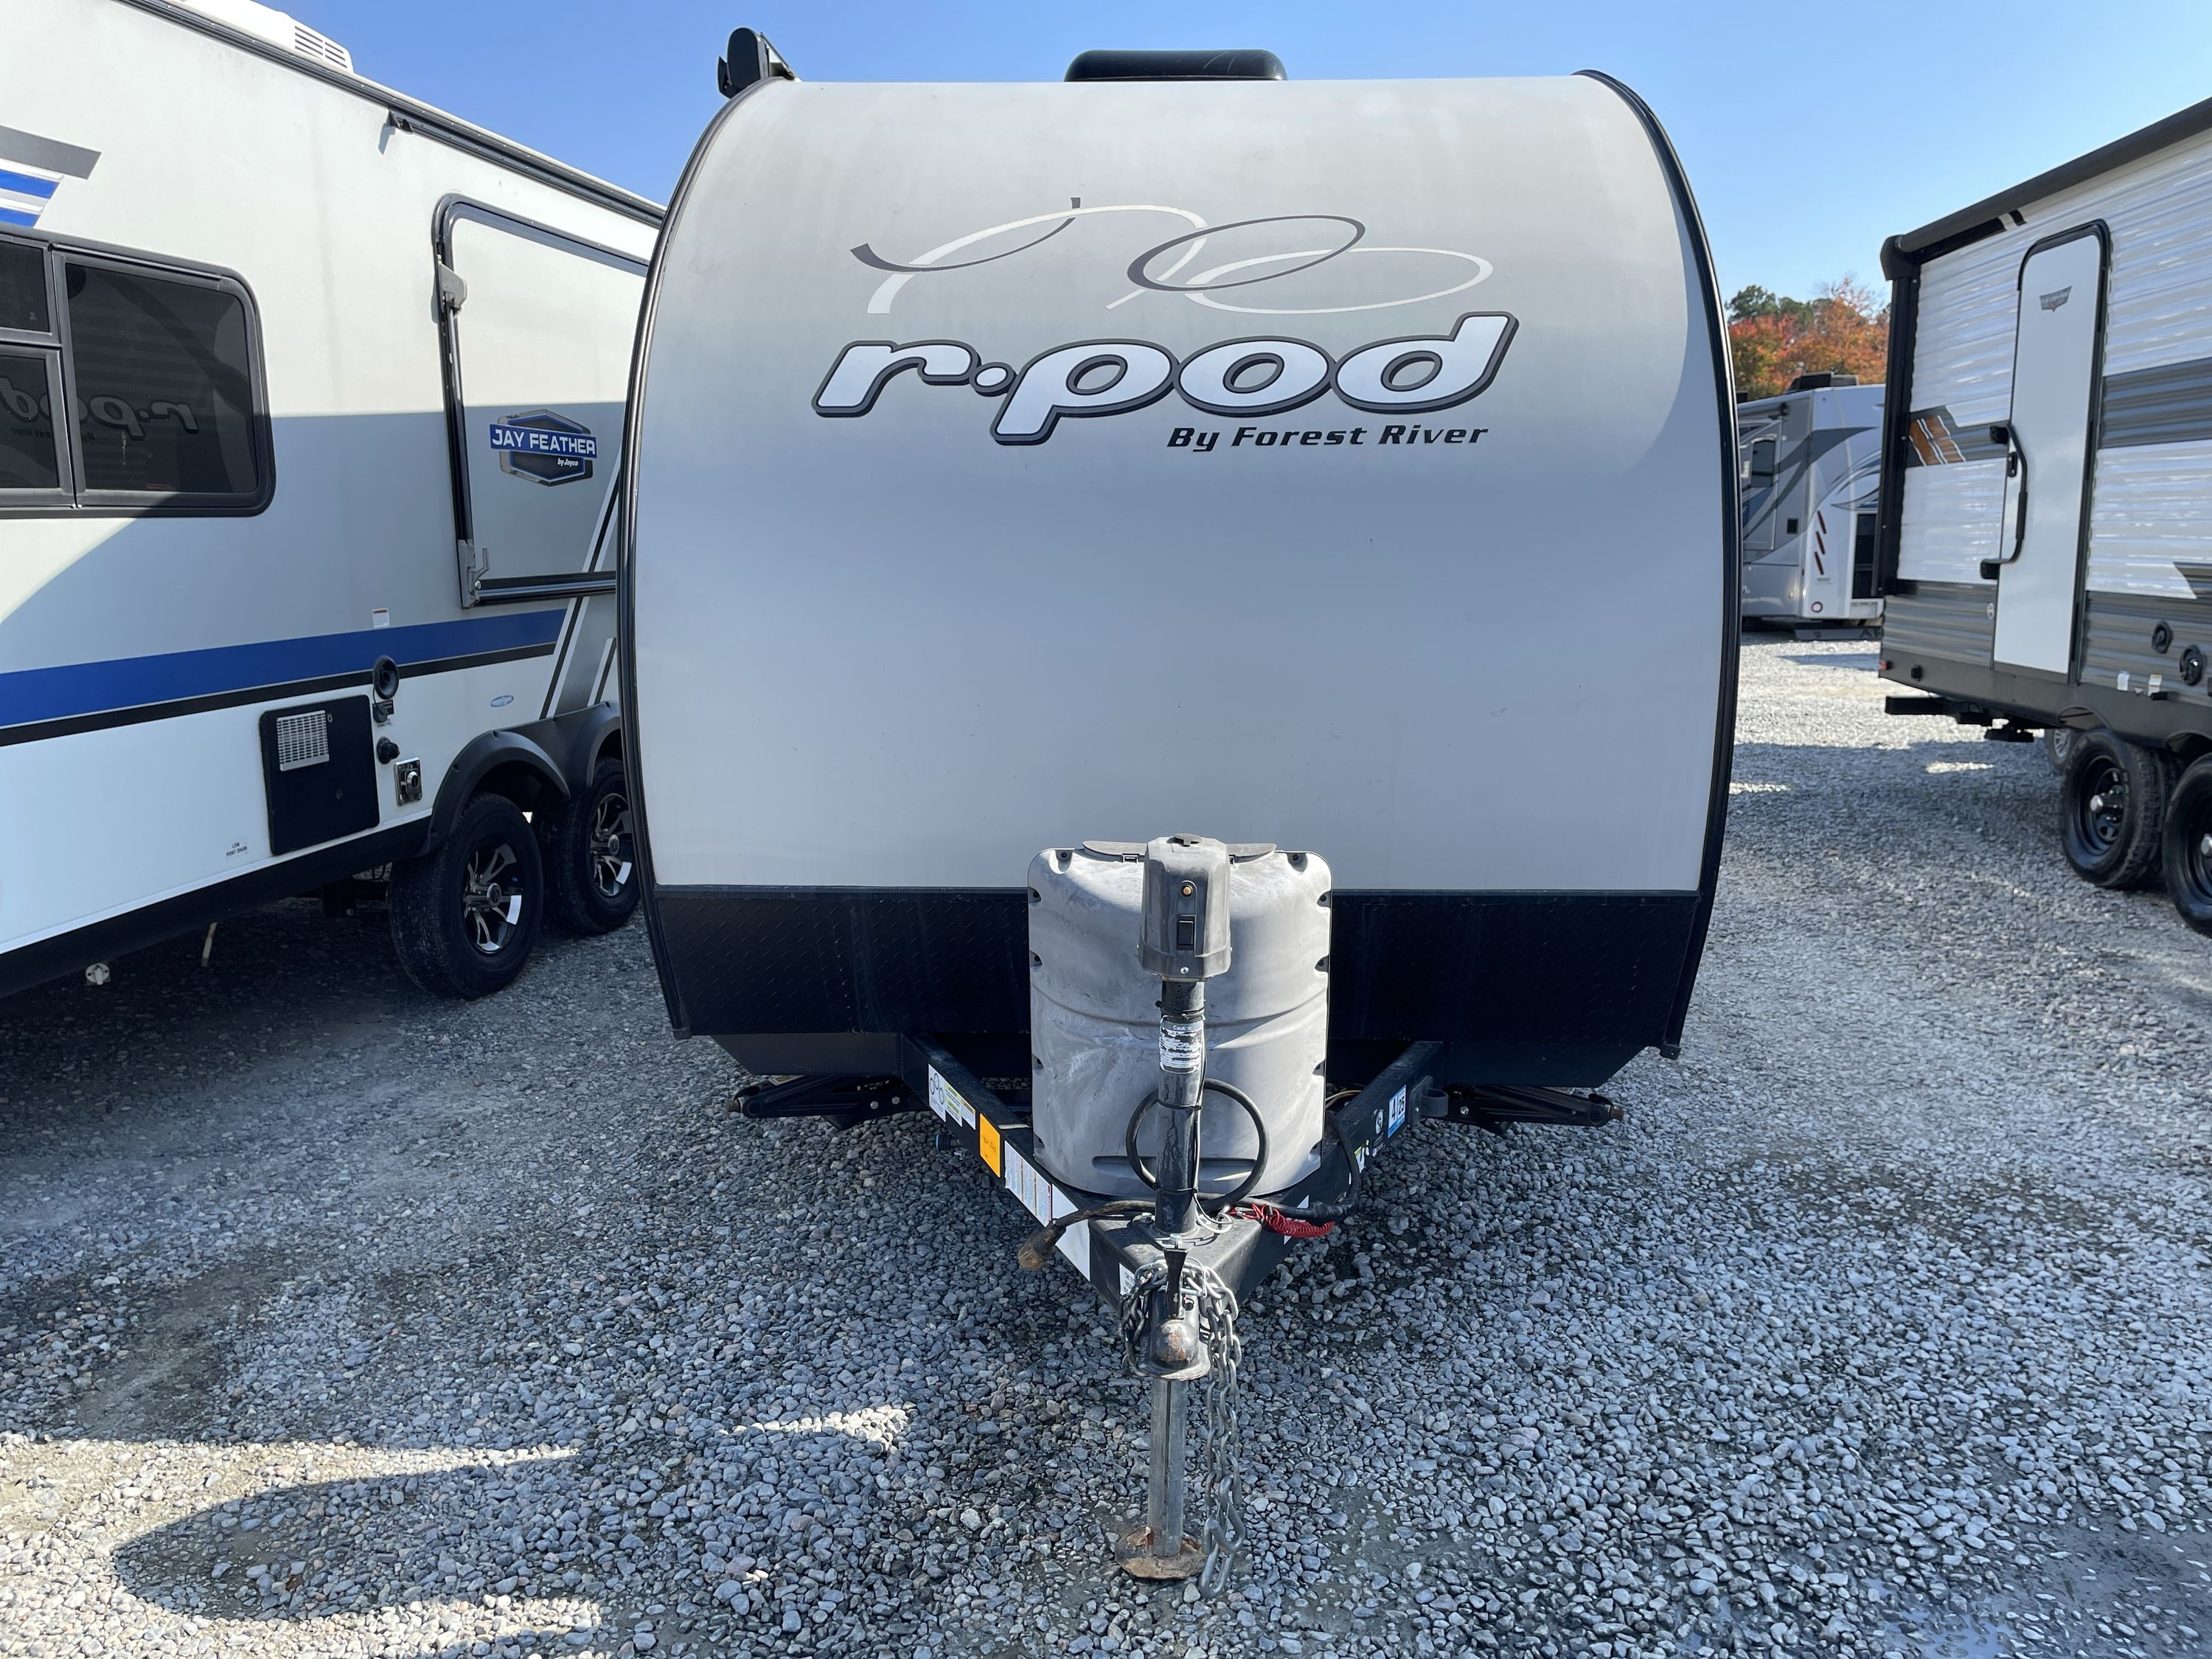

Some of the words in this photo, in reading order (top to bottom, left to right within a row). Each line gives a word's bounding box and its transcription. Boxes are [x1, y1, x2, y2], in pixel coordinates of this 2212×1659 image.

[492, 428, 525, 448] JAY
[529, 433, 596, 455] FEATHER
[1167, 428, 1220, 453] By
[1231, 426, 1367, 447] Forest
[1378, 424, 1489, 445] River
[557, 458, 564, 467] by
[564, 458, 579, 467] Jayco
[1391, 1098, 1397, 1121] 4
[1398, 1095, 1405, 1116] 25
